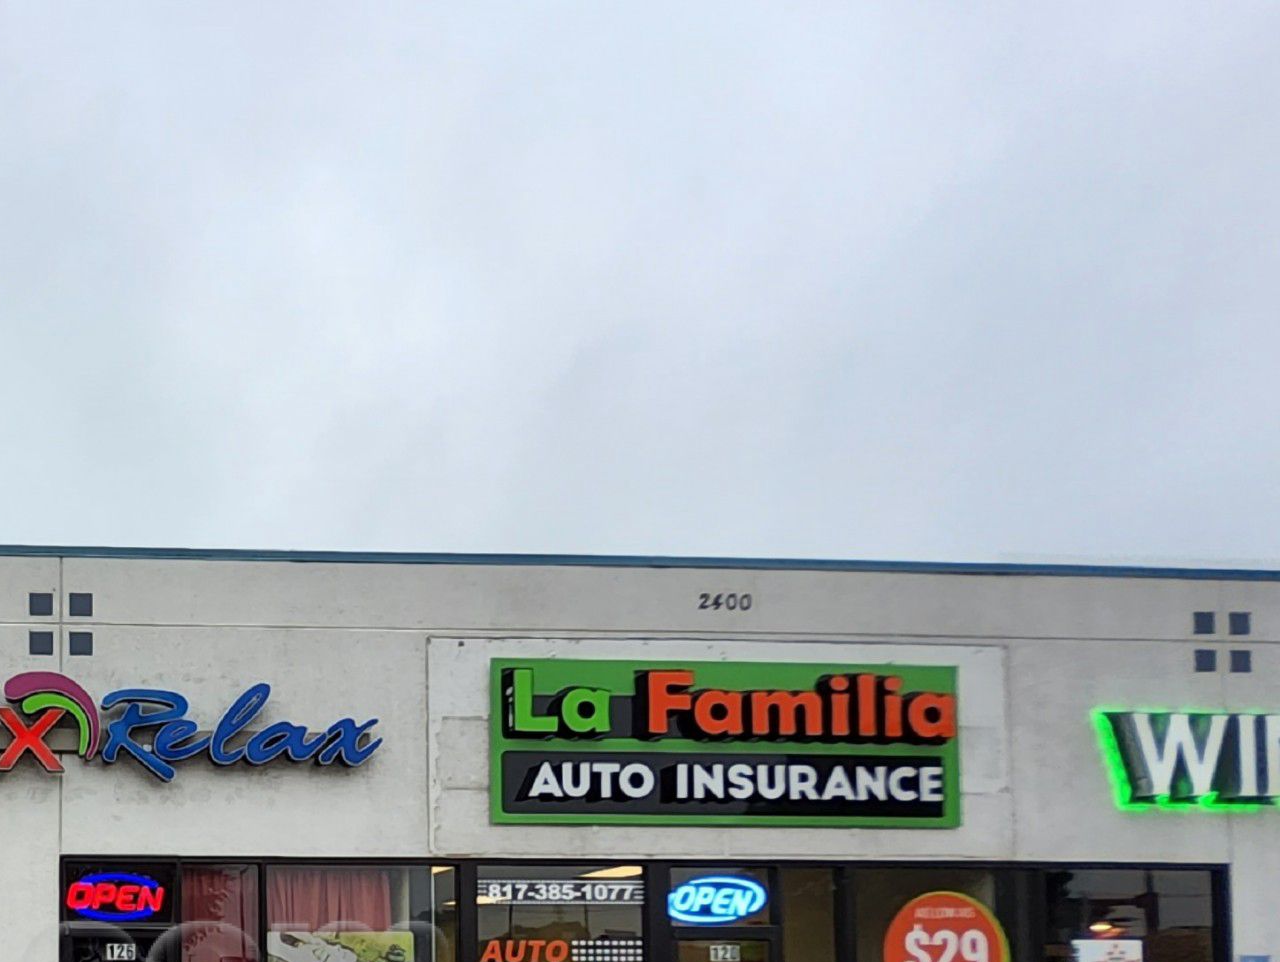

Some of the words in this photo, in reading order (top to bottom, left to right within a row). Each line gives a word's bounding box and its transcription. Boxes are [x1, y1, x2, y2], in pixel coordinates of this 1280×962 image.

[698, 593, 752, 611] 2400
[513, 668, 611, 732] La
[647, 669, 957, 738] Familia
[101, 683, 383, 783] Relax
[528, 761, 656, 799] AUTO
[675, 763, 945, 802] INSURANCE
[66, 882, 165, 912] OPEN
[488, 884, 635, 901] 817-385-1077
[672, 885, 754, 917] OPEN
[109, 945, 134, 960] 126
[480, 940, 570, 962] AUTO
